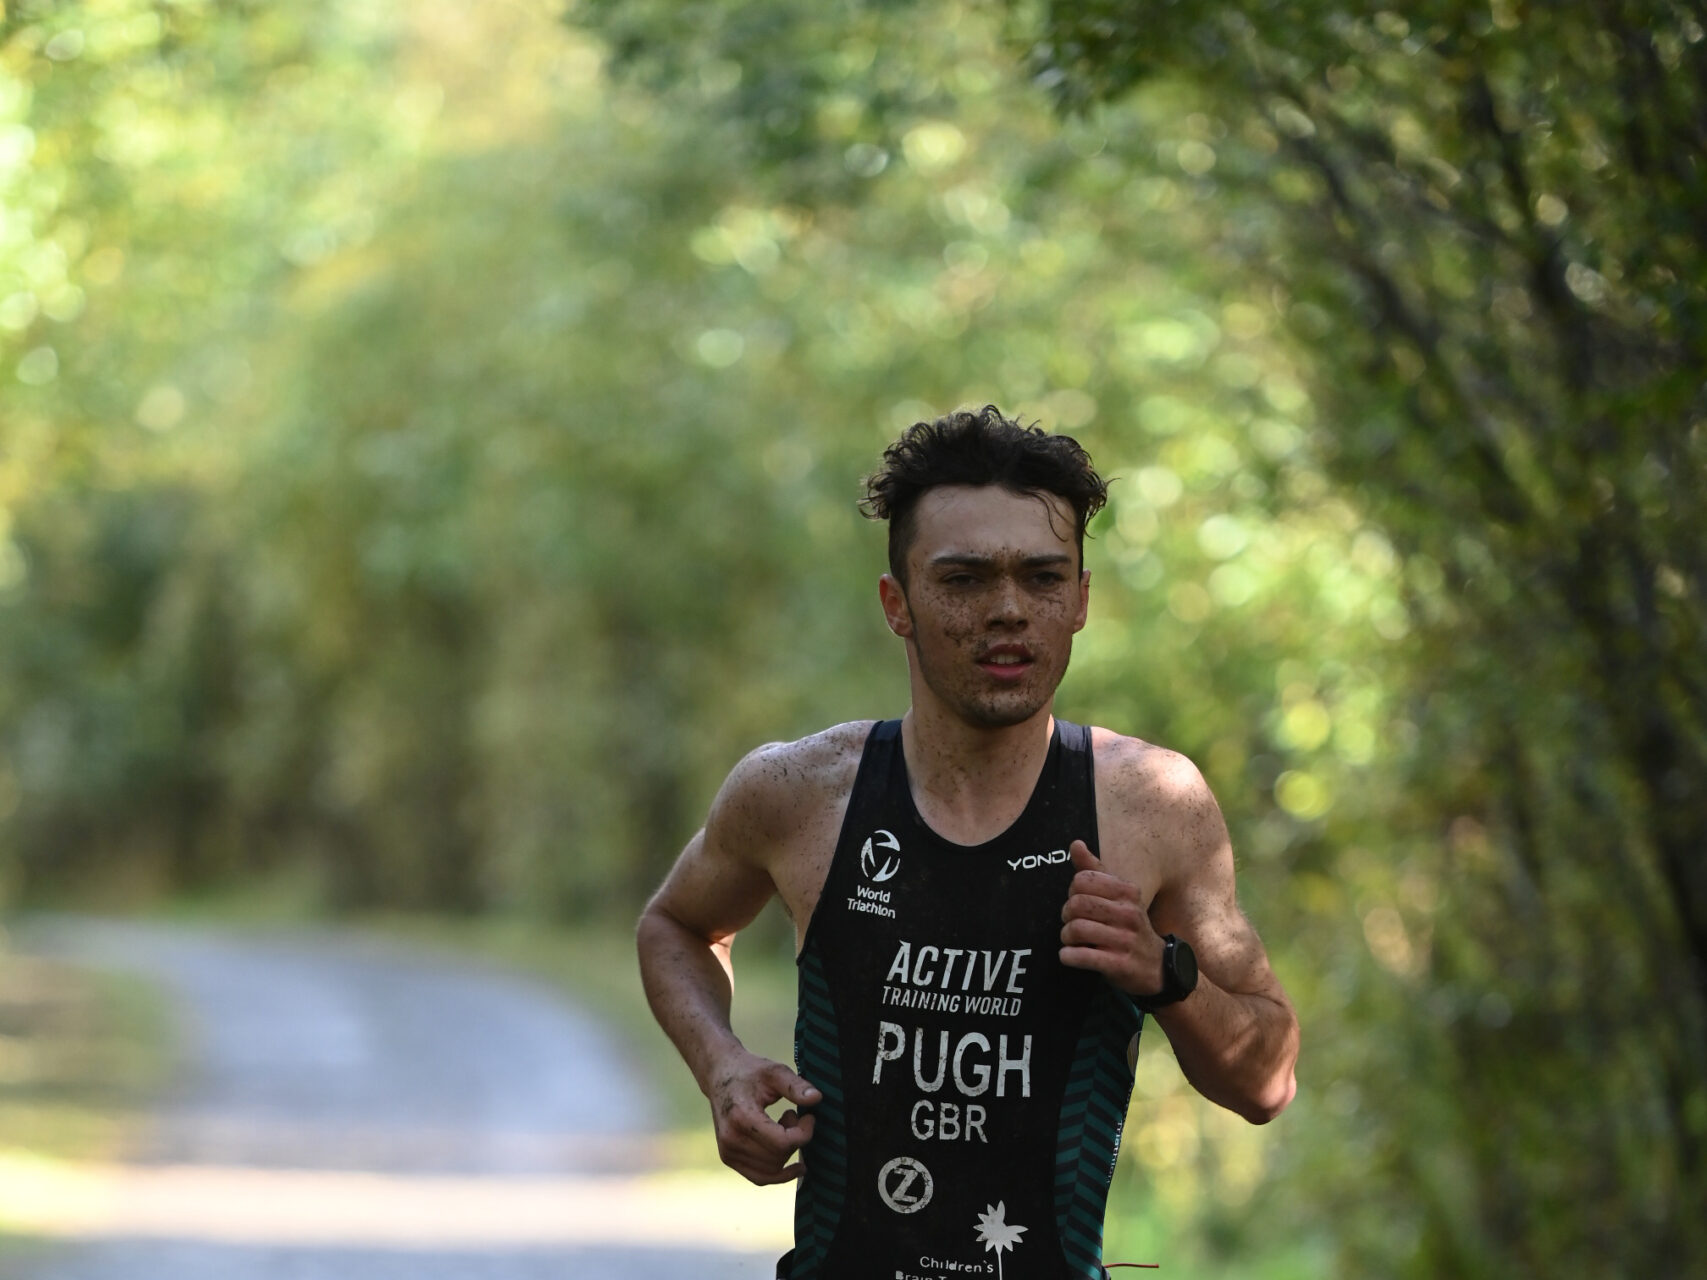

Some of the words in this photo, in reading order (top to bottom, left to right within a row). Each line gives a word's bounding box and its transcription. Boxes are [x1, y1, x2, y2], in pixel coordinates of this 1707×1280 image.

[846, 897, 897, 920] Triathlon
[856, 884, 892, 904] World
[883, 939, 1032, 994] ACTIVE
[882, 985, 961, 1014] TRAINING
[963, 994, 1023, 1017] WORLD
[872, 1020, 1033, 1098] PUGH
[910, 1099, 988, 1144] GBR
[919, 1255, 994, 1275] Children's
